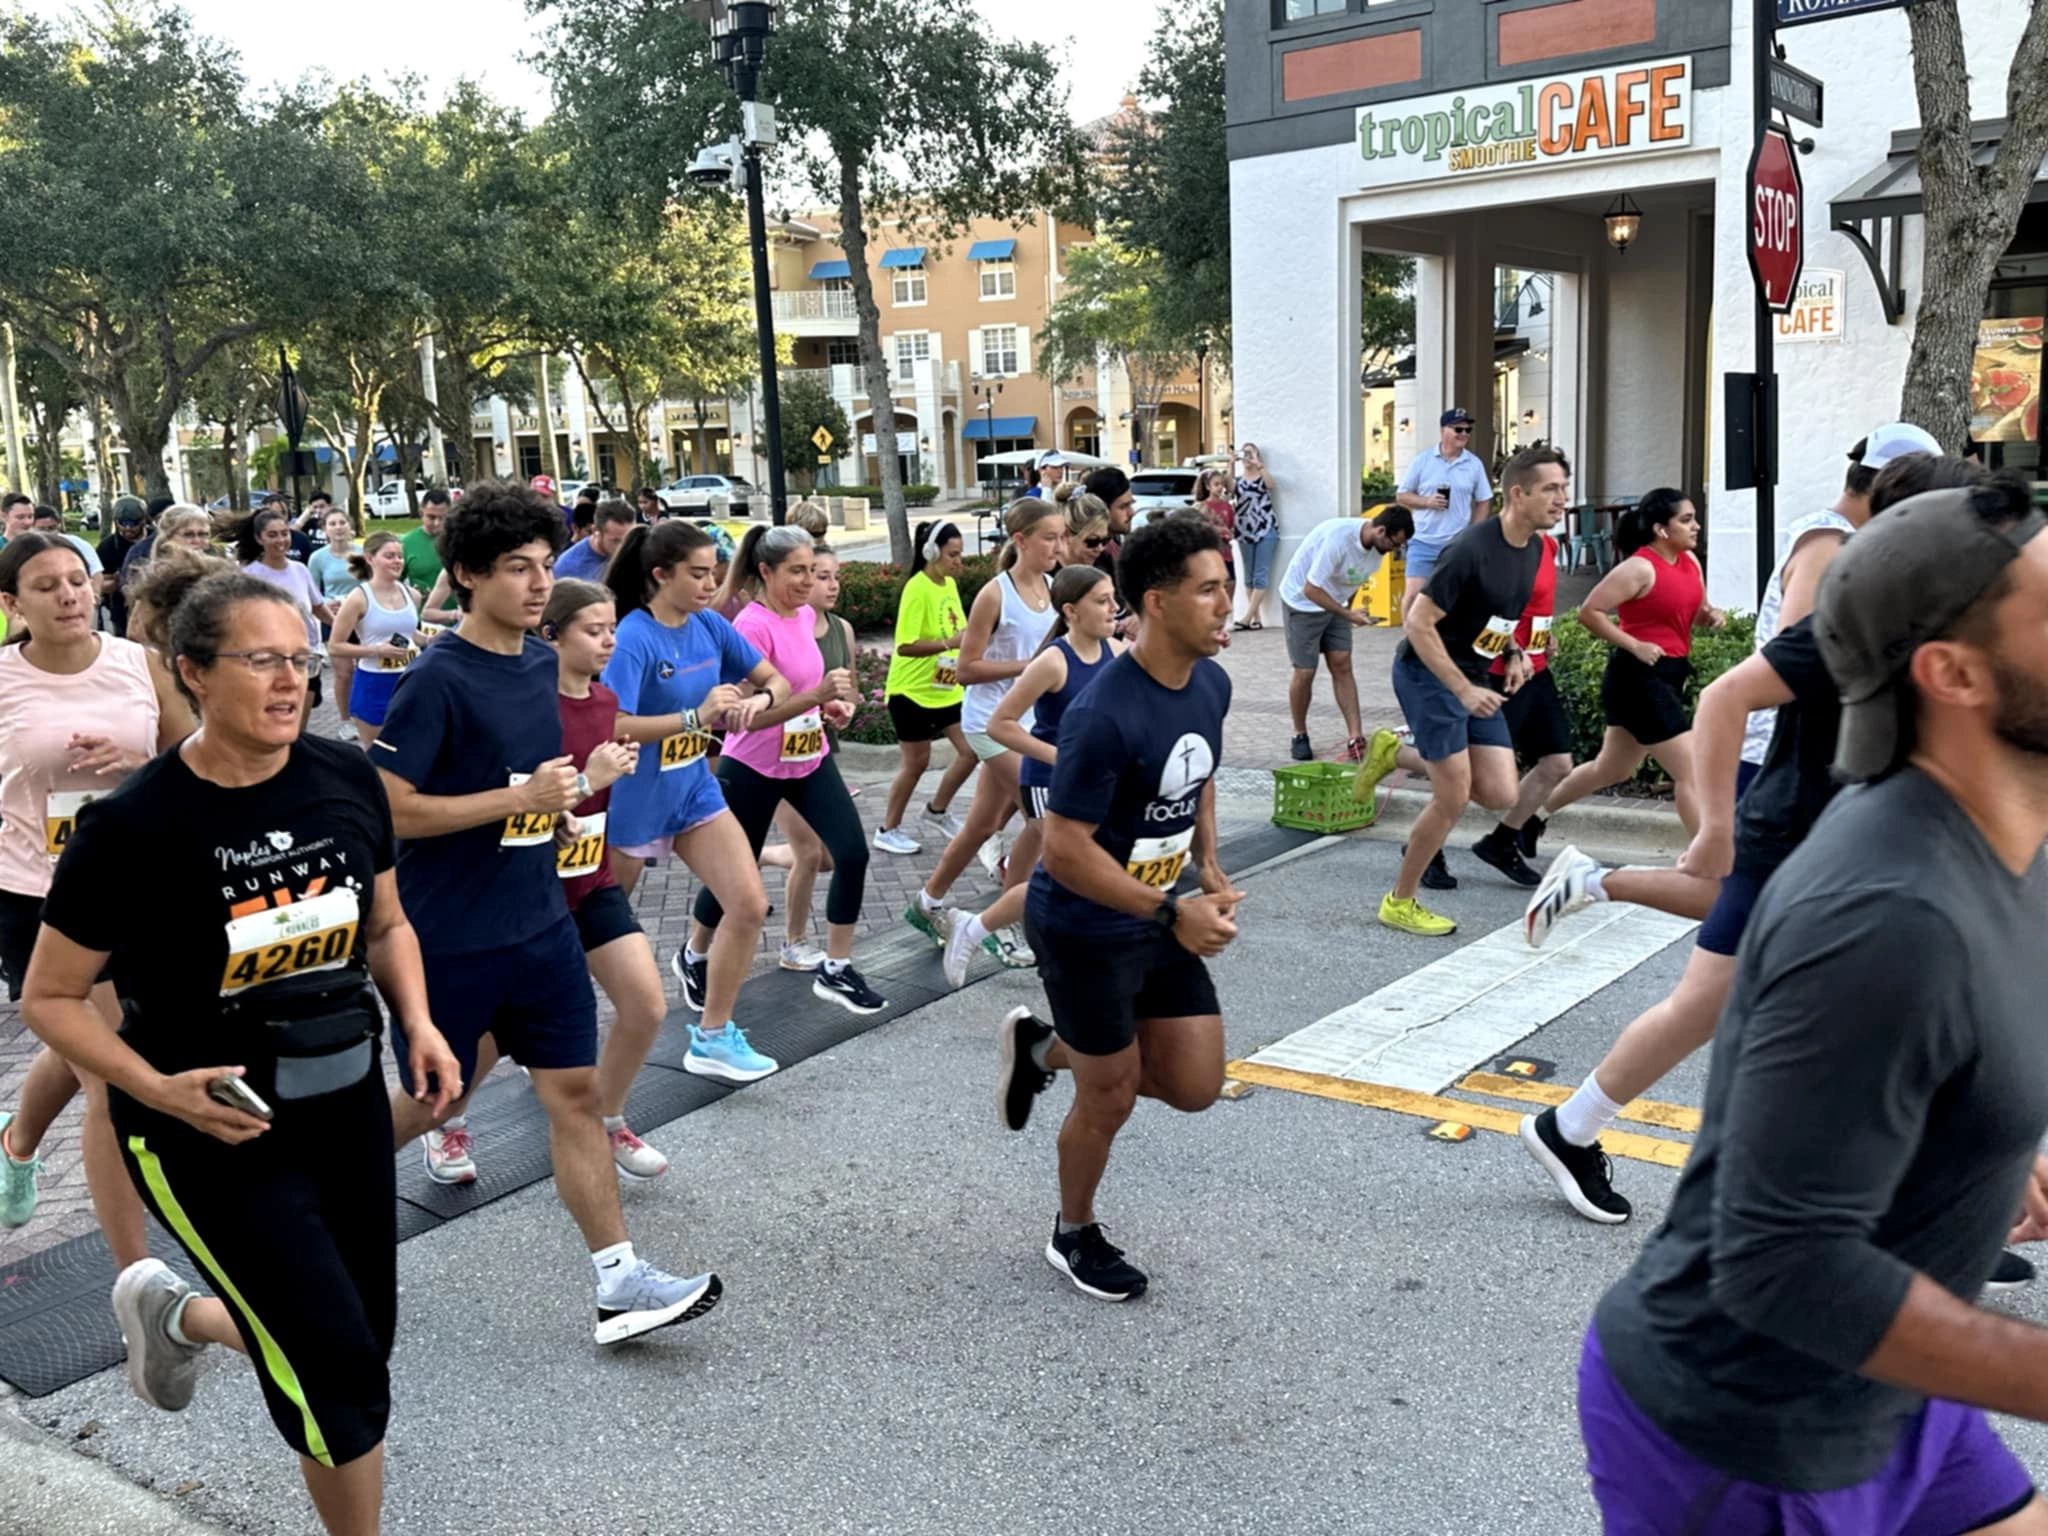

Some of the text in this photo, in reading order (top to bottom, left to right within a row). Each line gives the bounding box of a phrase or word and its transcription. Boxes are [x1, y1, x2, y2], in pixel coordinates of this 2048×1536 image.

[1360, 85, 1536, 162] tropical
[1538, 64, 1685, 156] CAFE
[1449, 139, 1537, 171] SMOOTHIE
[1754, 184, 1796, 253] STOP
[1779, 307, 1834, 335] CAFE
[214, 840, 271, 871] Naples
[221, 852, 347, 900] RUNWAY
[231, 927, 348, 984] 4260
